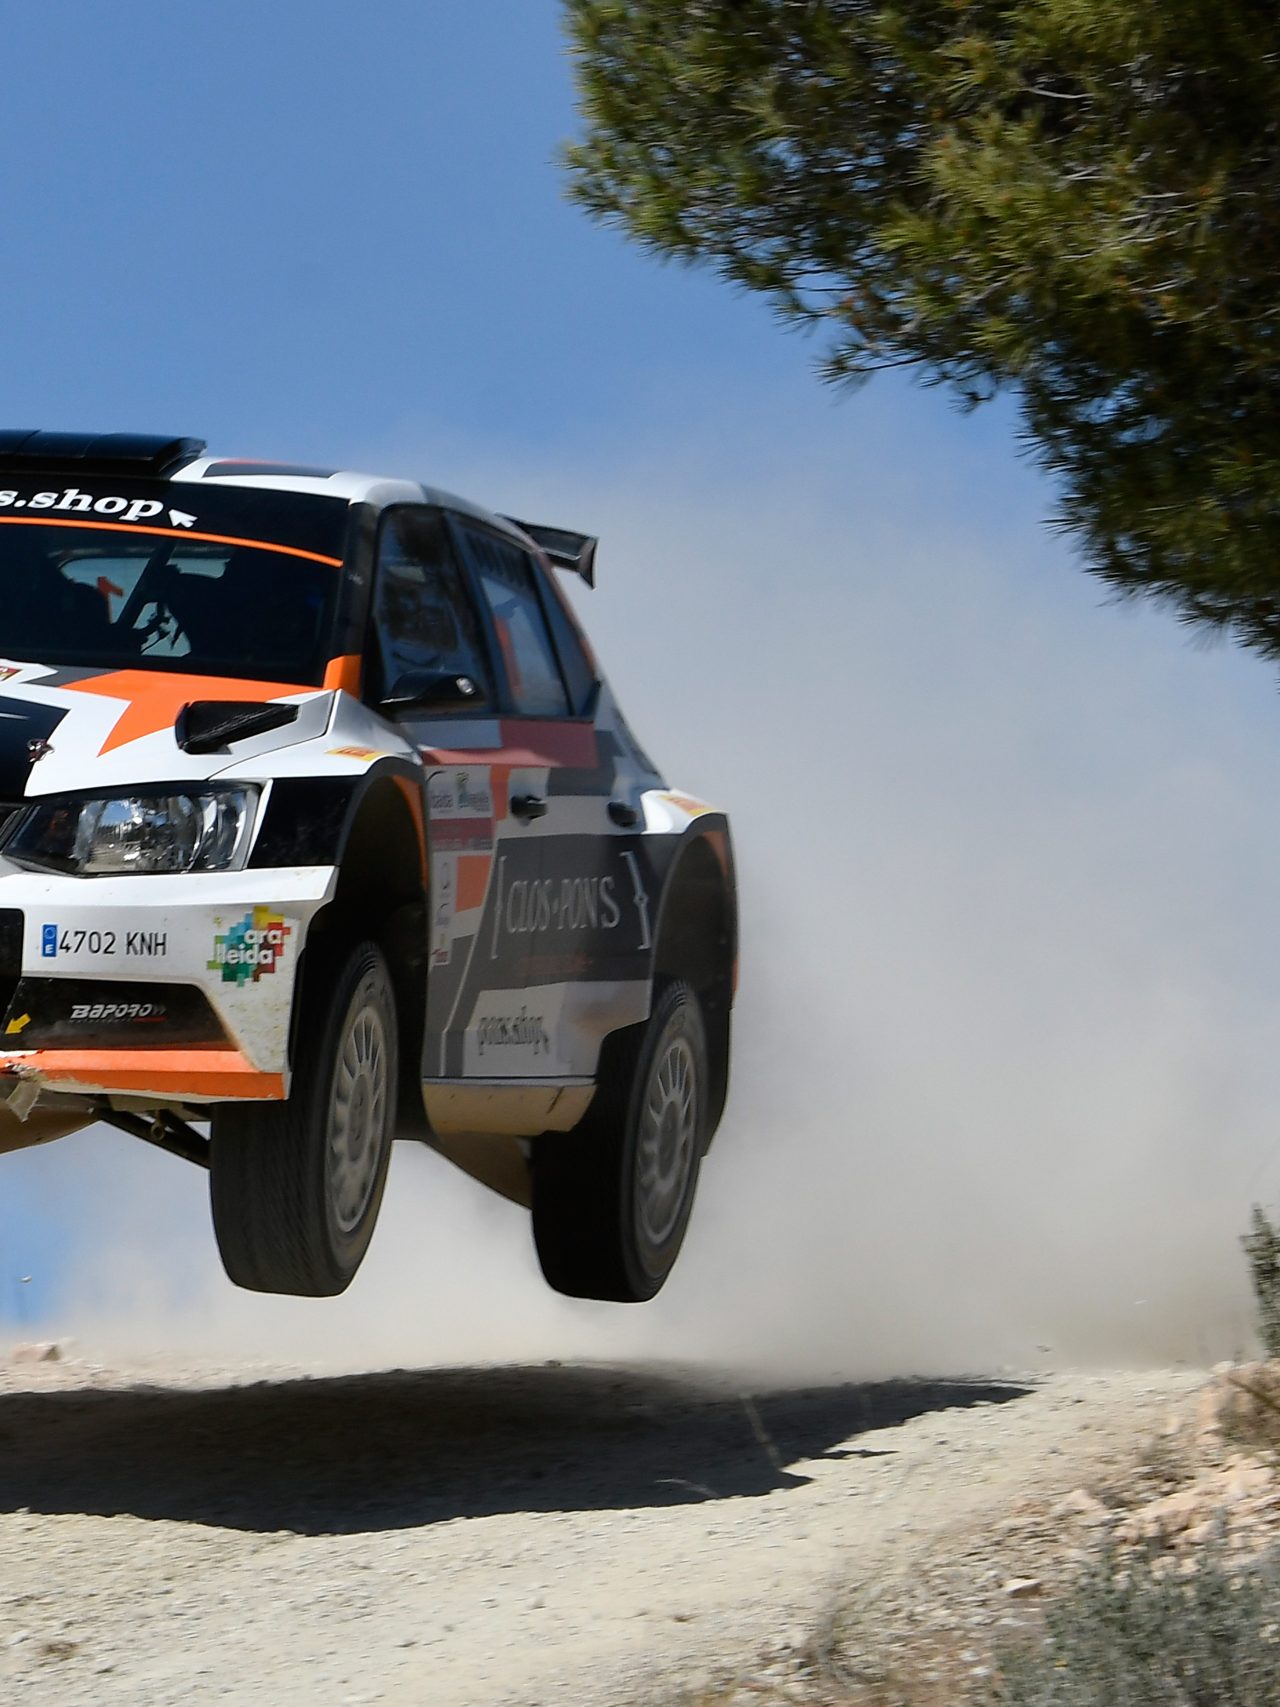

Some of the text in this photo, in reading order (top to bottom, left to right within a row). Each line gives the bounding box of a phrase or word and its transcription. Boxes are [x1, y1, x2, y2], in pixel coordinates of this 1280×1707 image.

[59, 931, 167, 956] 4702 KNH
[244, 930, 283, 944] ara
